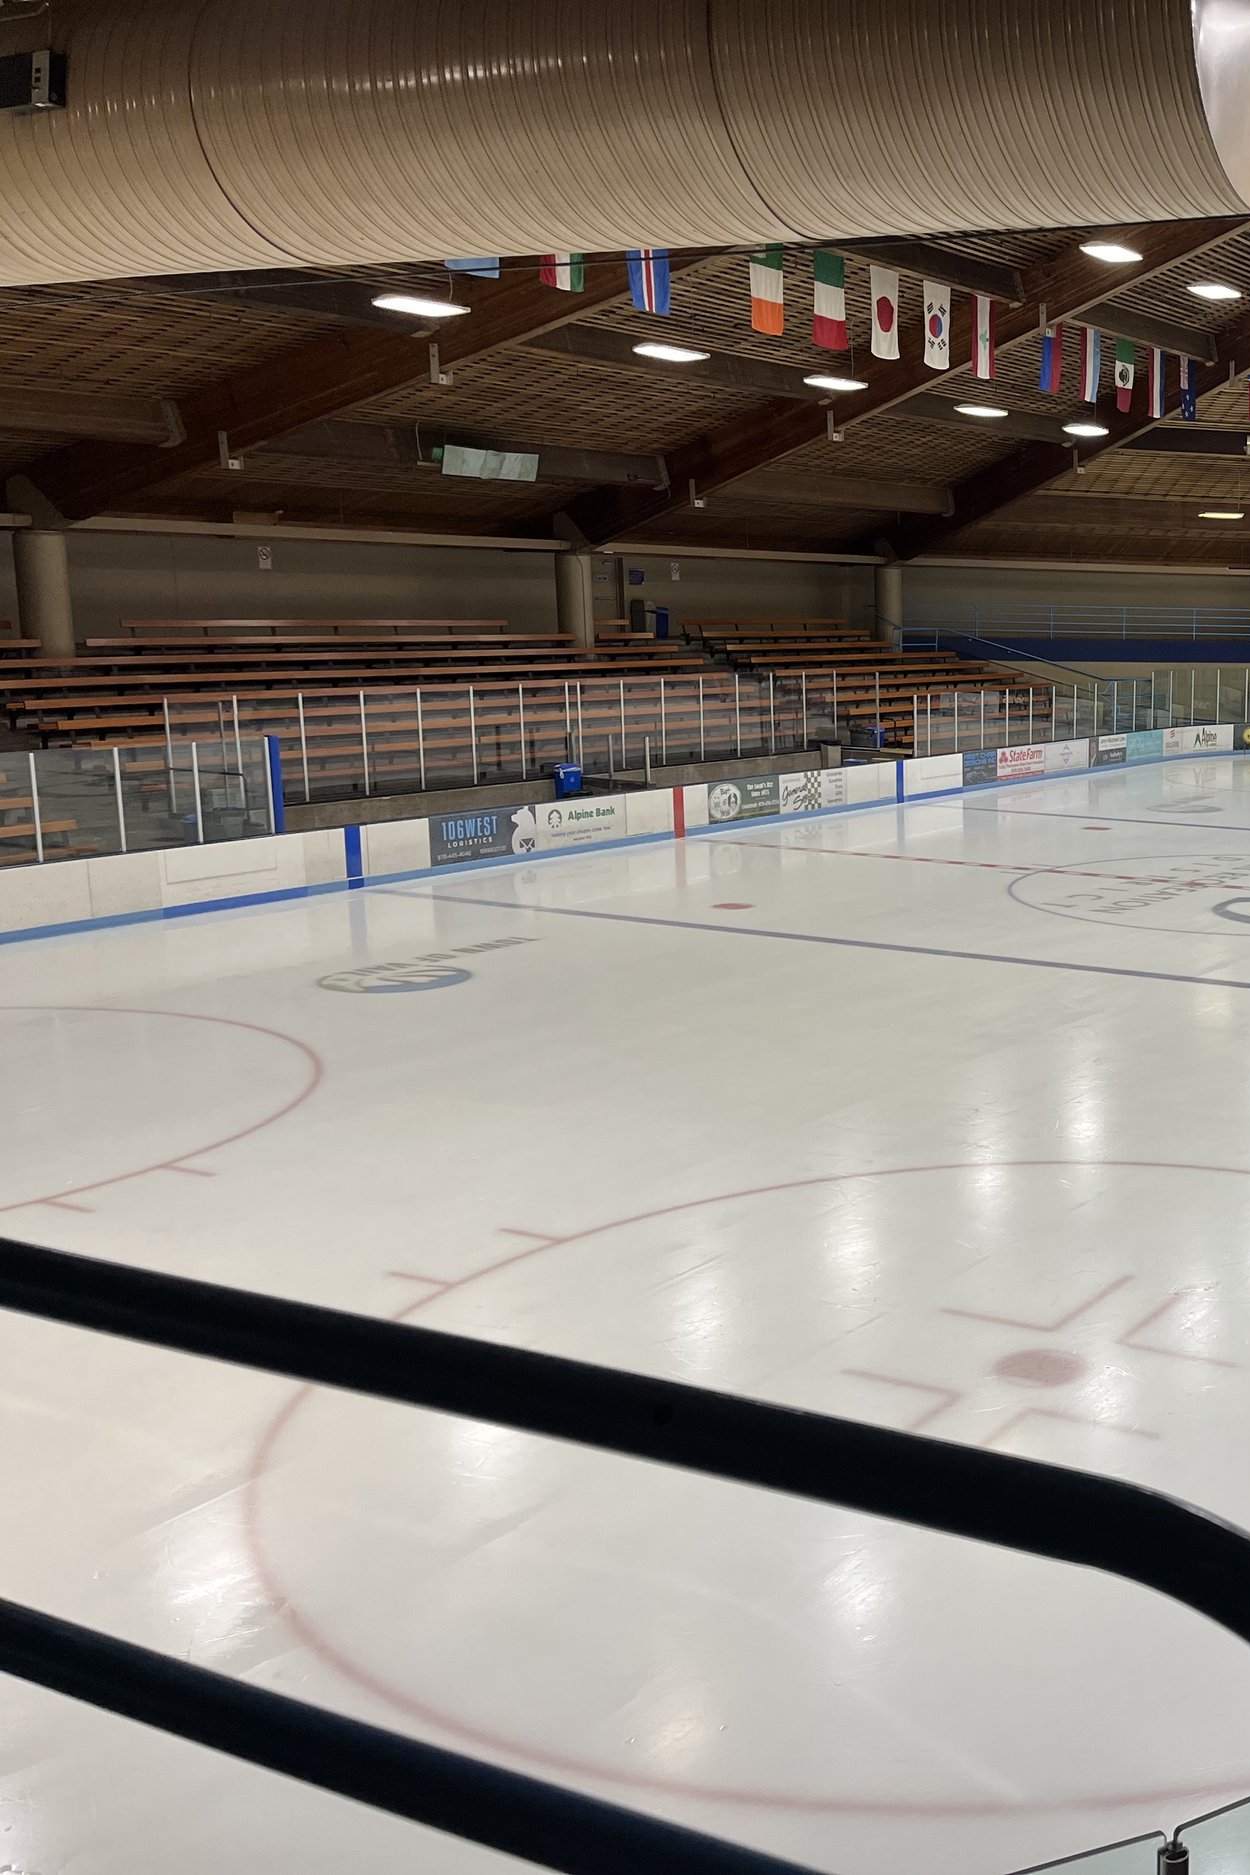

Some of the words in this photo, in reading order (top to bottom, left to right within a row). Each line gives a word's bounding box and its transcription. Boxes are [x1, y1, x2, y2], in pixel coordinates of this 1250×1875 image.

[567, 809, 594, 821] Alpine
[595, 805, 616, 817] Bank
[441, 815, 498, 841] 106WEST
[447, 836, 494, 849] LOGISTICS
[450, 936, 540, 954] TOWN
[413, 953, 458, 964] OF
[342, 962, 419, 976] VAIL
